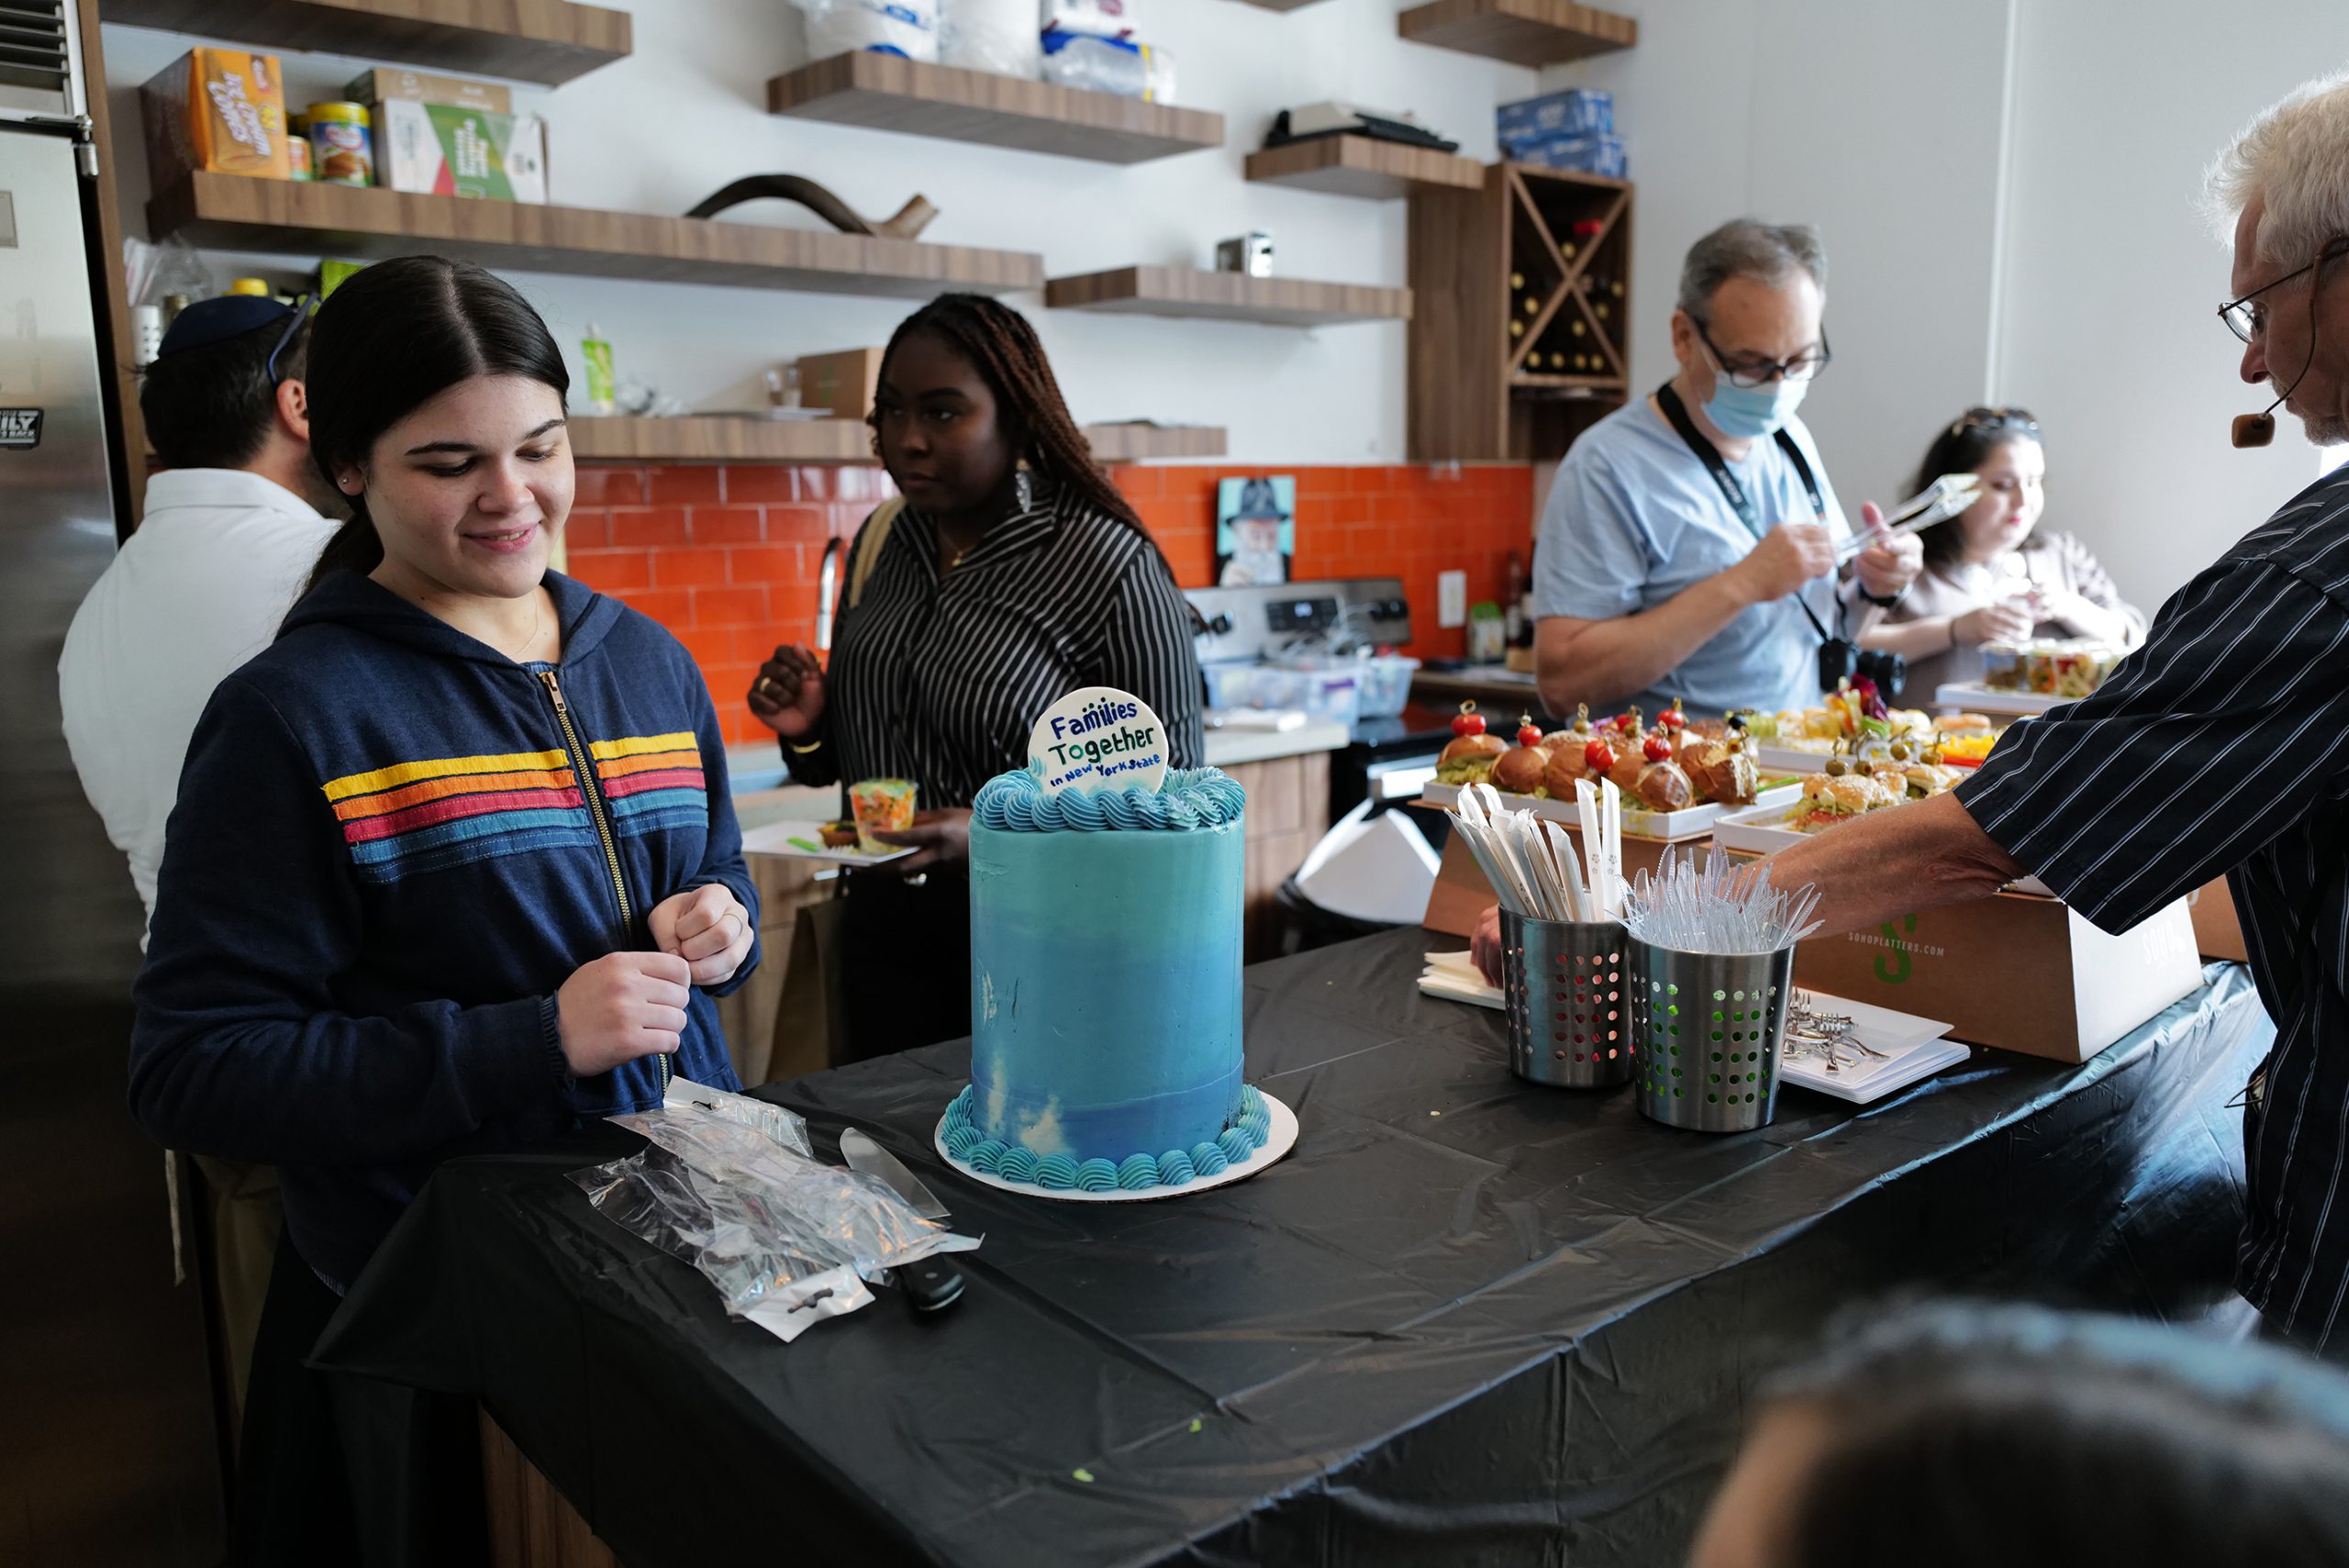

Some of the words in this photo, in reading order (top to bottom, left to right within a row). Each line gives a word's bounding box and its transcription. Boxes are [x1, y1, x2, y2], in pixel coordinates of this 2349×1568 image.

[1050, 701, 1138, 740] Families
[1048, 726, 1154, 765] Together
[1064, 763, 1093, 782] New
[1096, 762, 1127, 777] York
[1129, 753, 1161, 770] State
[1848, 931, 1944, 956] SOHOPLATTERS.COM
[2142, 920, 2175, 965] SOHO
